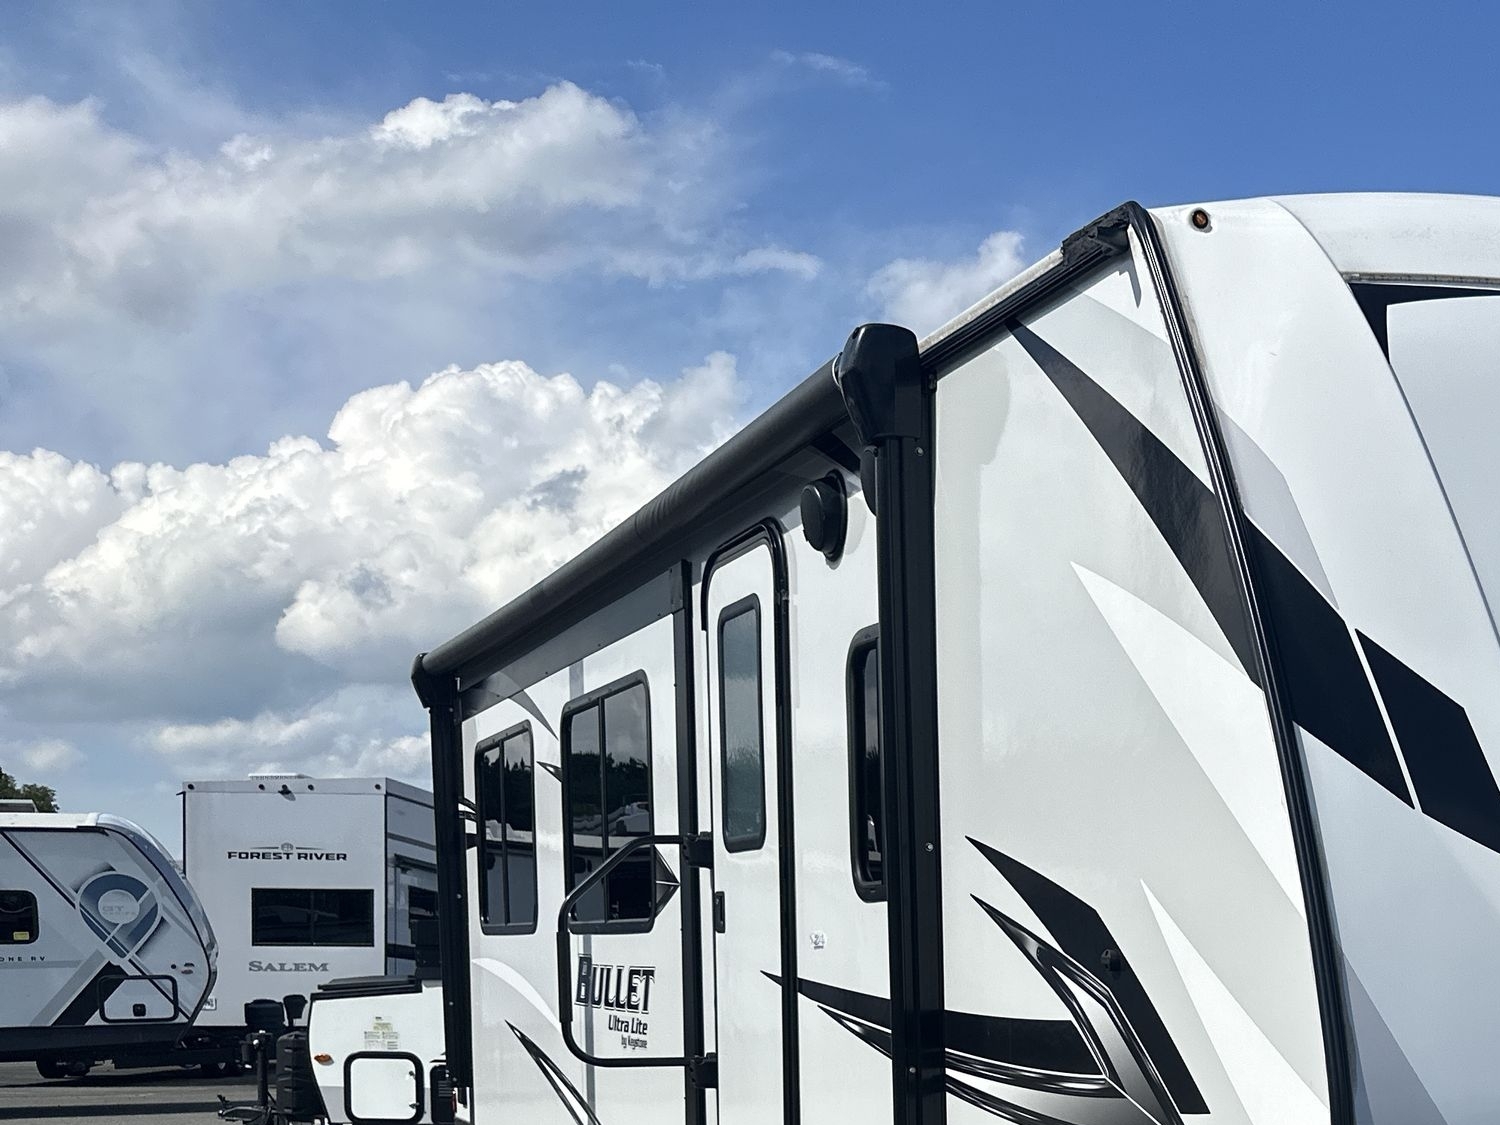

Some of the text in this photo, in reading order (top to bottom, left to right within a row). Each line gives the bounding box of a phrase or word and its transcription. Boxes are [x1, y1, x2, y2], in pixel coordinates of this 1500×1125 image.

[227, 851, 347, 861] FOREST RIVER
[248, 960, 329, 972] SALEM
[574, 953, 655, 1014] BULLET
[608, 1014, 648, 1035] Ultra Lite
